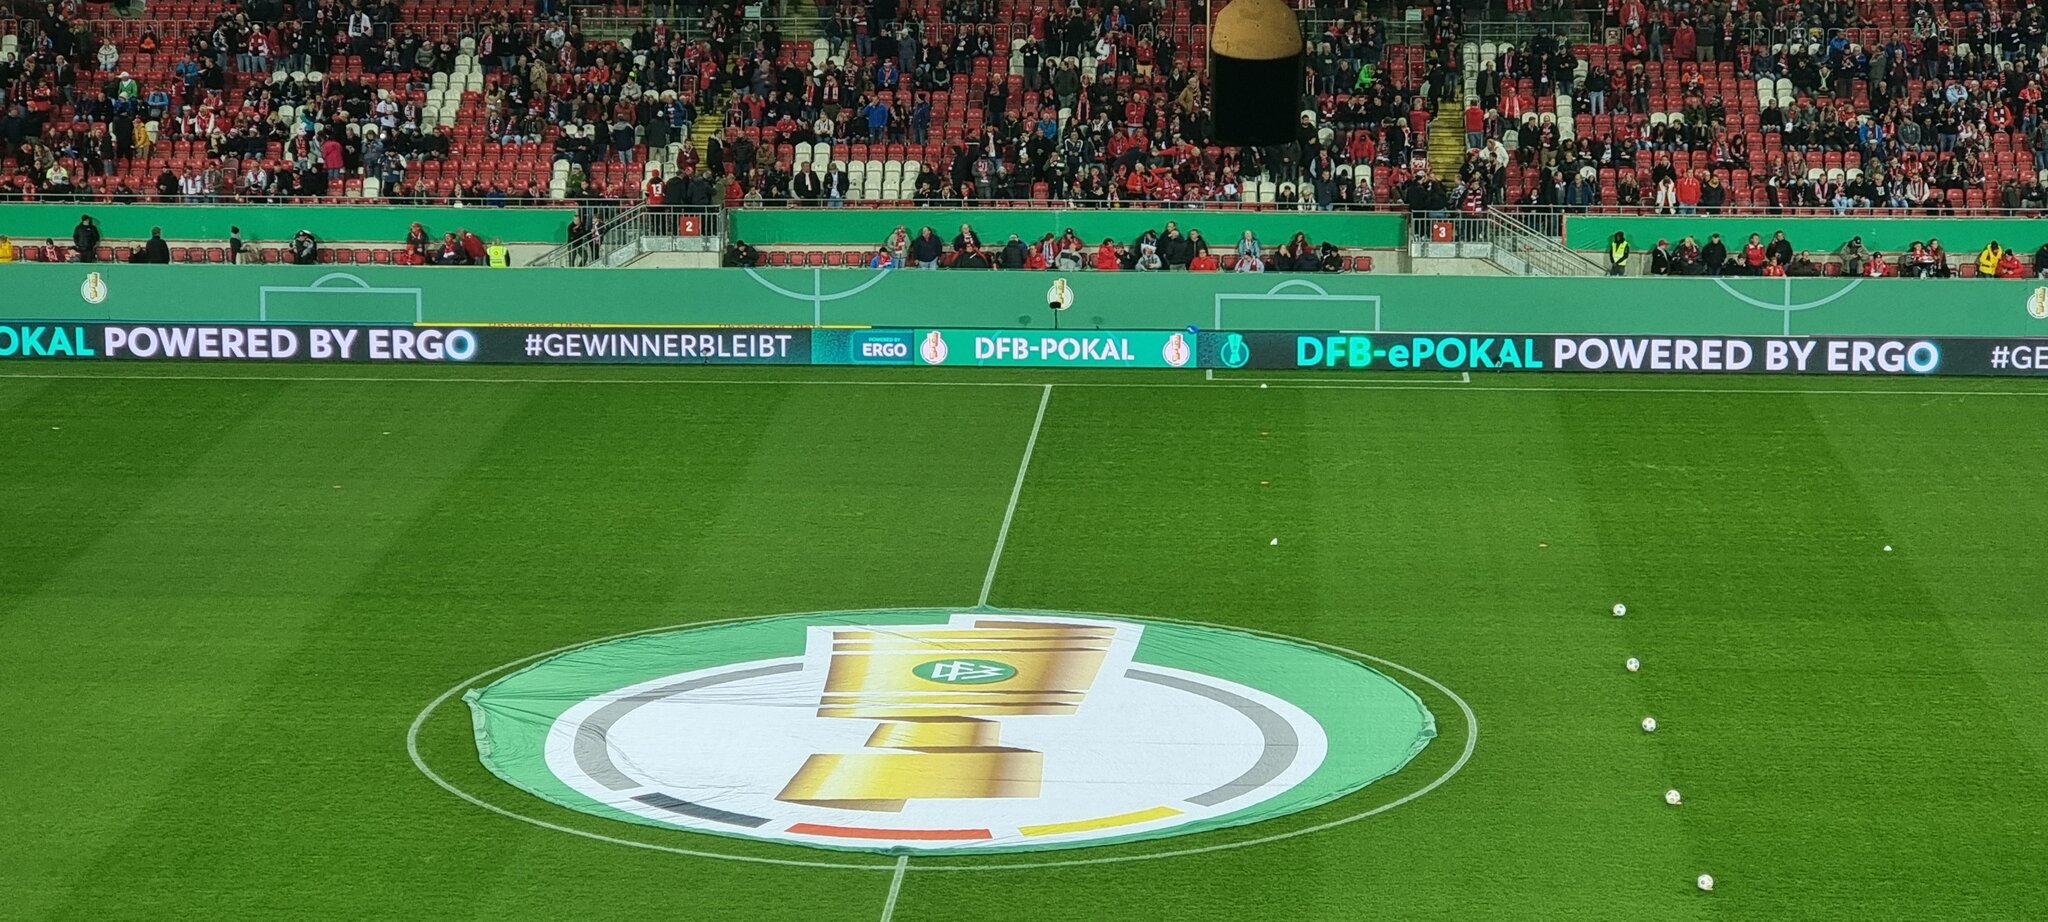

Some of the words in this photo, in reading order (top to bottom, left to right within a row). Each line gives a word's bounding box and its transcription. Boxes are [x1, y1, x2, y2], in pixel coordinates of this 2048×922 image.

[651, 183, 662, 195] 13
[686, 221, 693, 232] 2
[1439, 227, 1446, 238] 3
[104, 326, 298, 358] POWERED
[309, 328, 358, 359] BY
[368, 329, 476, 360] ERGO
[524, 333, 792, 357] #GEWINNERBLEIBT
[862, 343, 907, 357] ERGO
[975, 337, 1135, 360] DFB-POKAL
[1297, 336, 1543, 370] DFB-ePOKAL
[1554, 338, 1753, 370] POWERED
[1766, 340, 1817, 371] BY
[1827, 341, 1939, 372] ERGO
